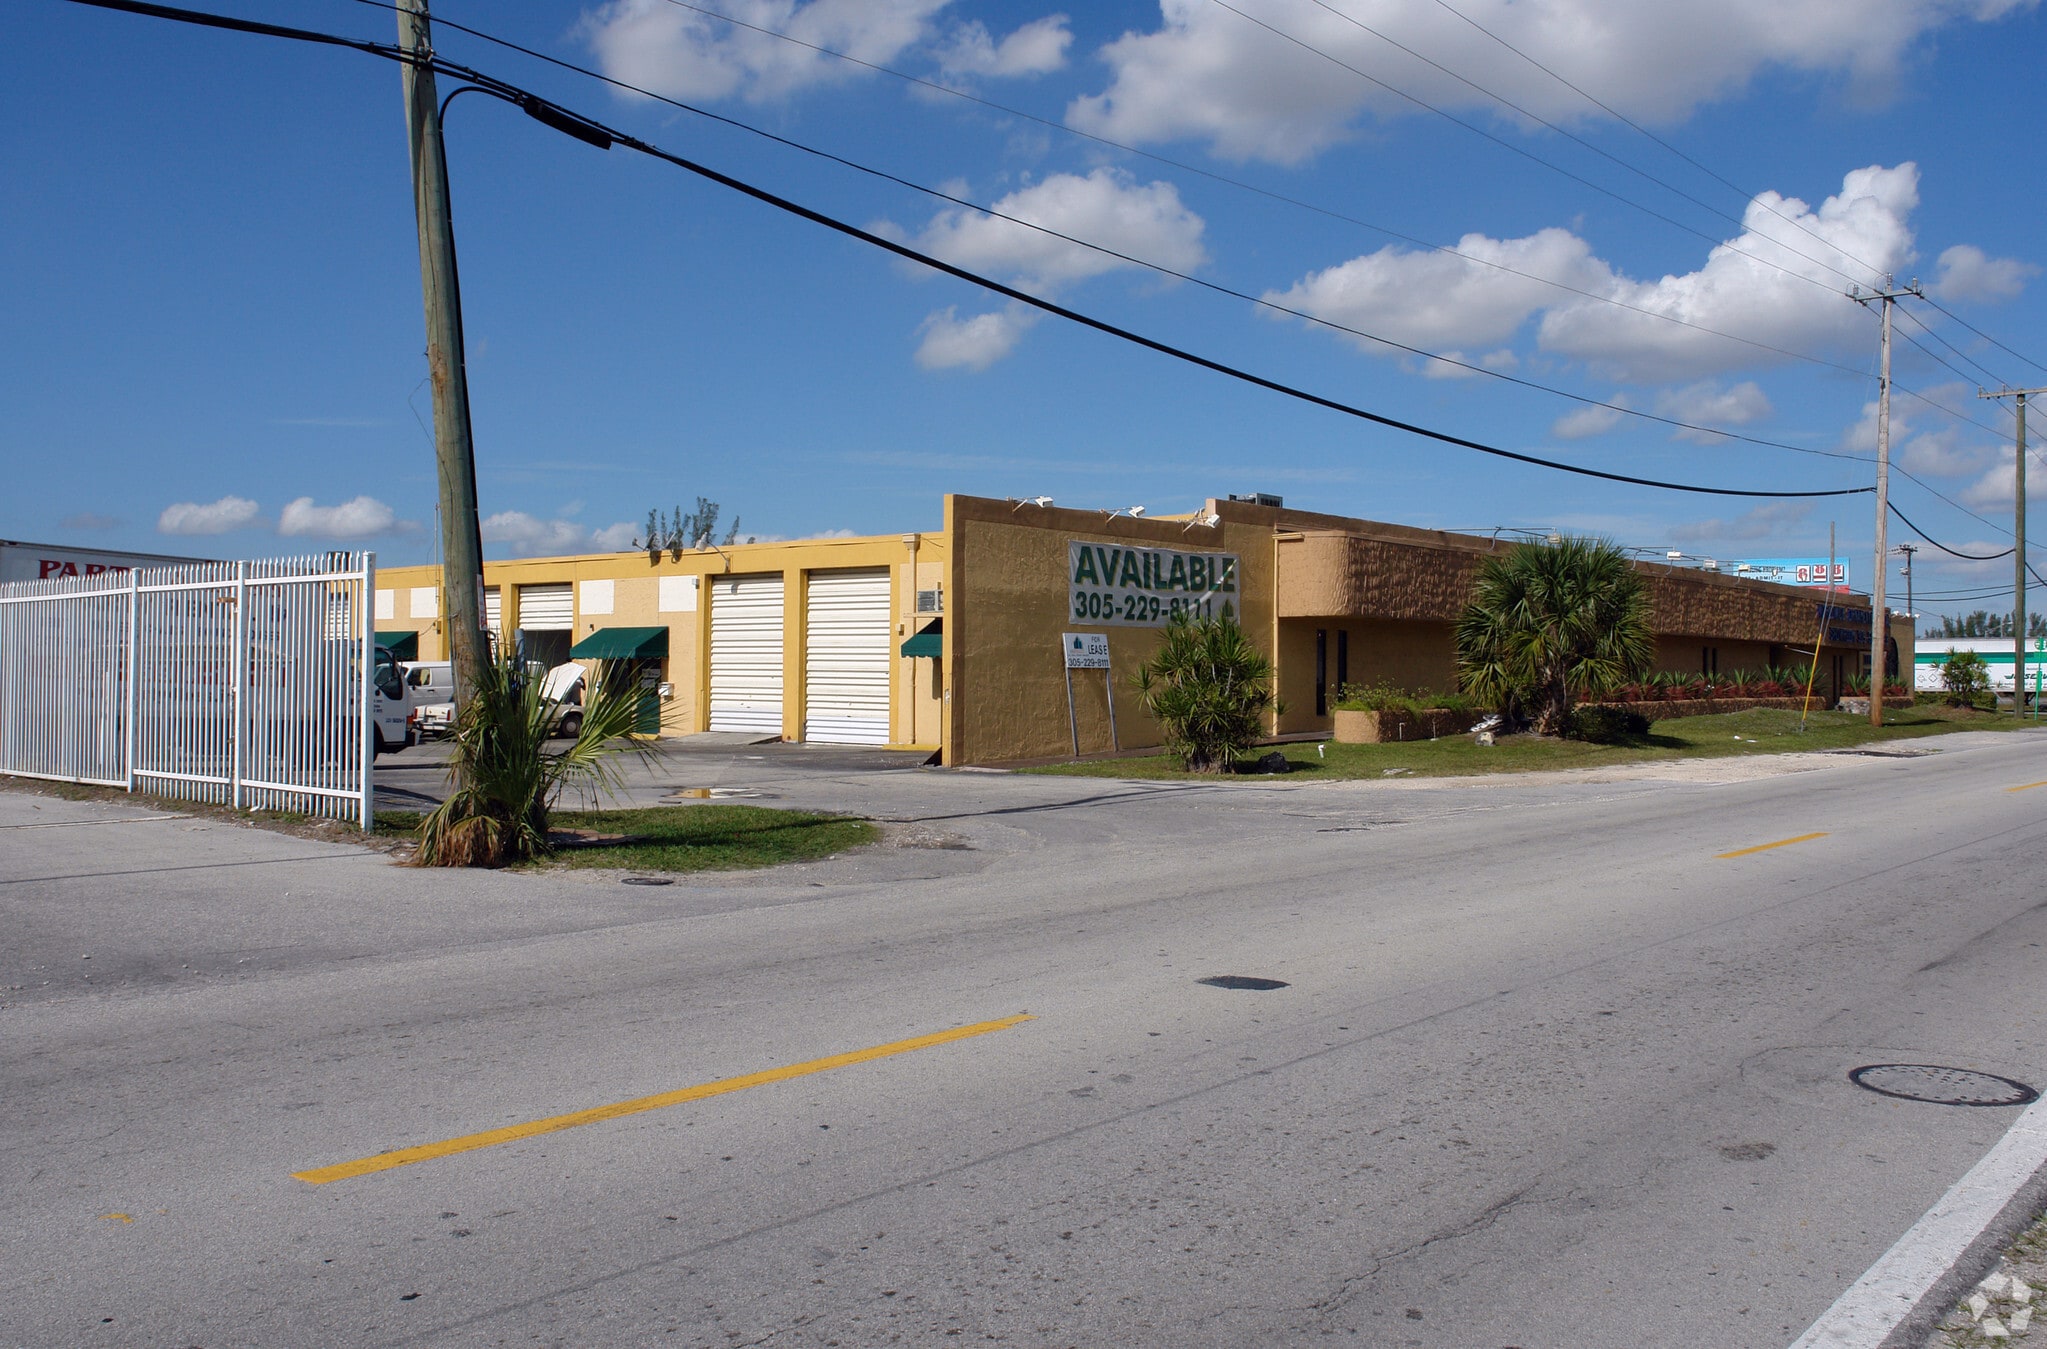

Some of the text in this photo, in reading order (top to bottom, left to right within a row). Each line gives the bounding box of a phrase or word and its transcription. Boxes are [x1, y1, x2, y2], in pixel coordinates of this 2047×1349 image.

[1074, 545, 1236, 592] AVAILABLE
[1075, 591, 1212, 622] 305-229-8111
[1088, 644, 1108, 655] LEASE
[1068, 658, 1109, 667] 305-229-8111
